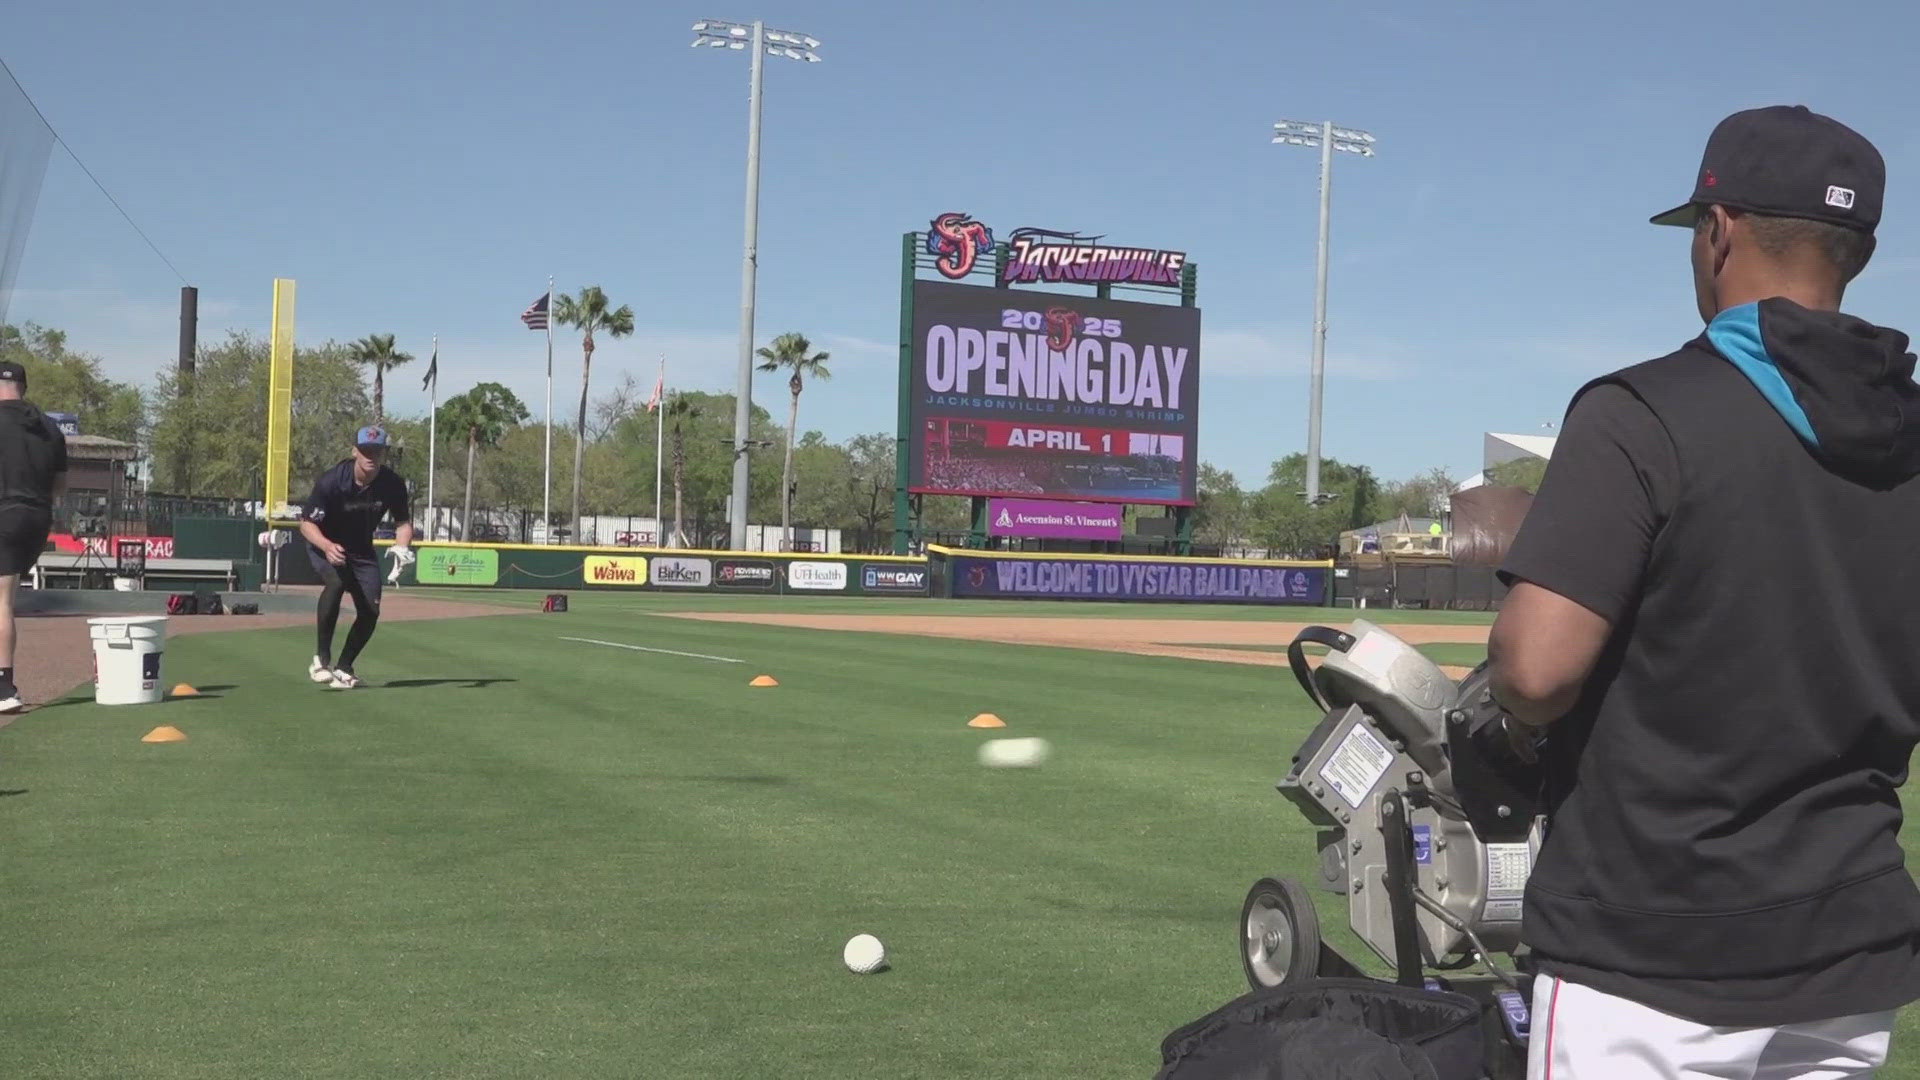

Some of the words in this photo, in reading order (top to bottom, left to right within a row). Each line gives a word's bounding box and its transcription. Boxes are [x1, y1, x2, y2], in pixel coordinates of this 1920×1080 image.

[1004, 238, 1185, 286] JACKSONVILLE
[1002, 309, 1041, 329] 20
[1083, 317, 1122, 338] 25
[926, 324, 1104, 404] OPENING
[1109, 341, 1188, 409] DAY
[926, 395, 1056, 412] JACKSONVILLE
[1063, 404, 1118, 417] JUMBO
[1125, 409, 1185, 422] SHRIMP
[1007, 428, 1091, 451] APRIL
[1101, 434, 1111, 452] 1
[1016, 513, 1062, 525] Ascension
[1064, 515, 1076, 526] St.
[1076, 516, 1117, 527] Vincent's
[594, 566, 635, 581] Wawa
[996, 561, 1093, 592] WELCOME
[1096, 564, 1119, 593] TO
[1121, 565, 1191, 595] VYSTAR
[1195, 567, 1286, 597] BALLPARK
